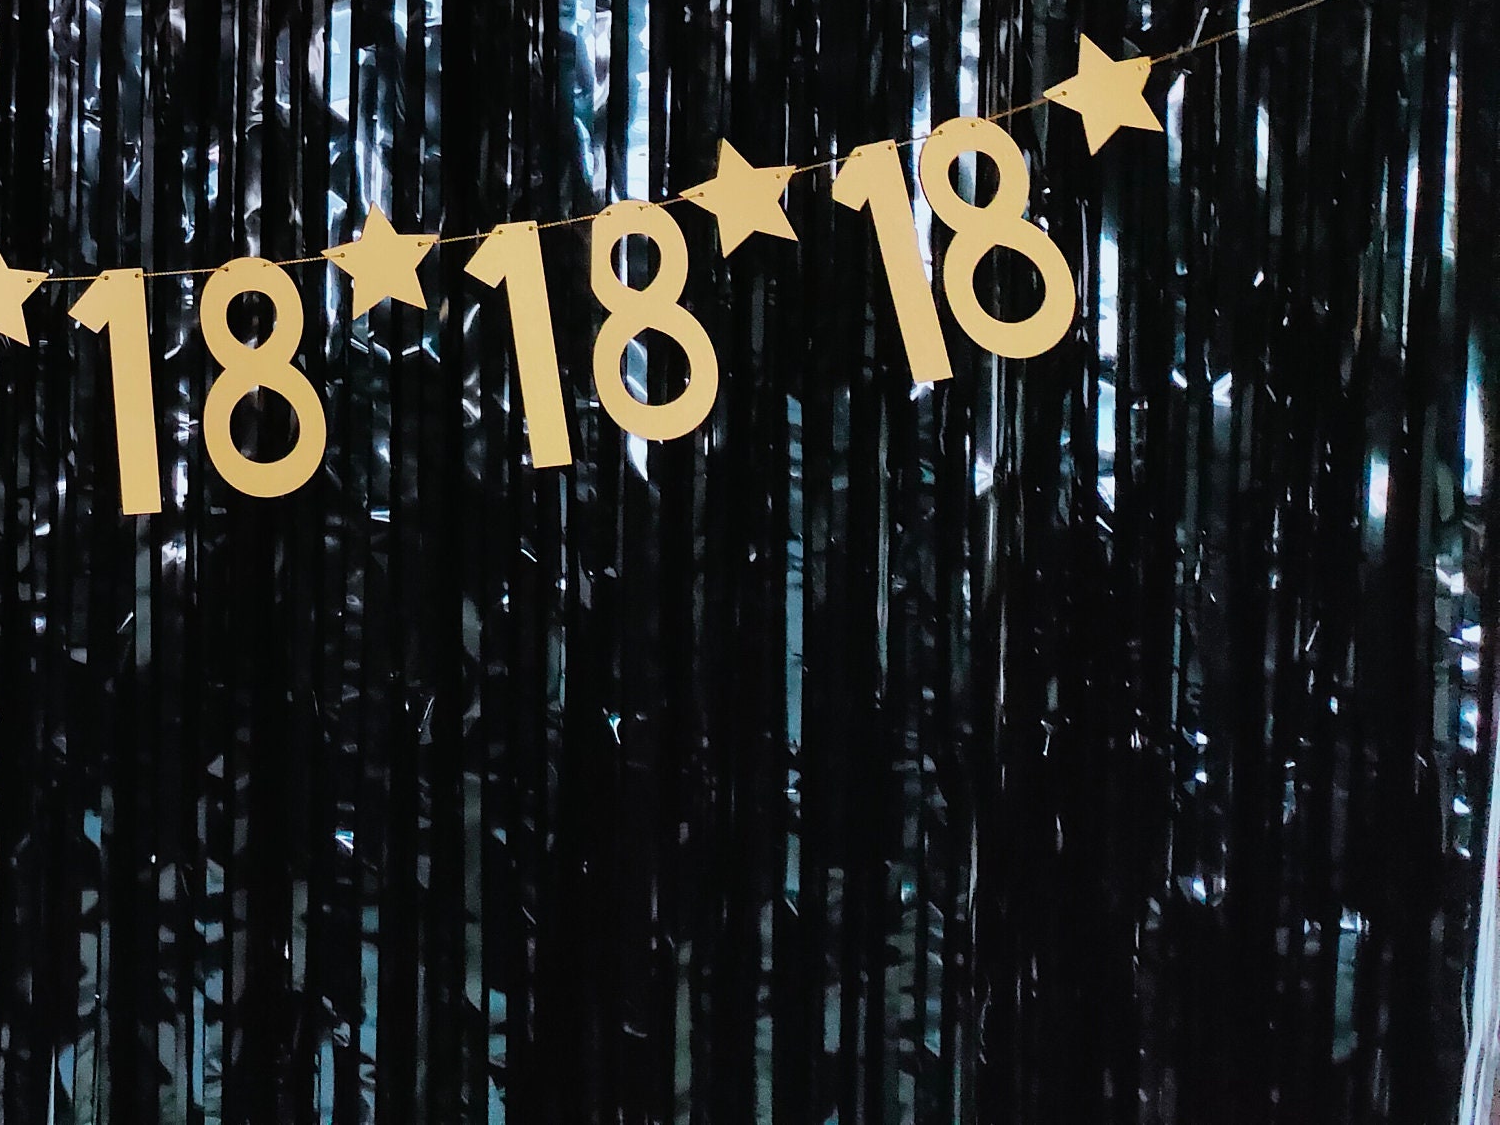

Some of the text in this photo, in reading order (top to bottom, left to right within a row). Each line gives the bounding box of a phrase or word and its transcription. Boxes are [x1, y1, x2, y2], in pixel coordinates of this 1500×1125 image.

[67, 257, 327, 516] 18
[464, 199, 719, 469] 18
[832, 116, 1077, 382] 18
